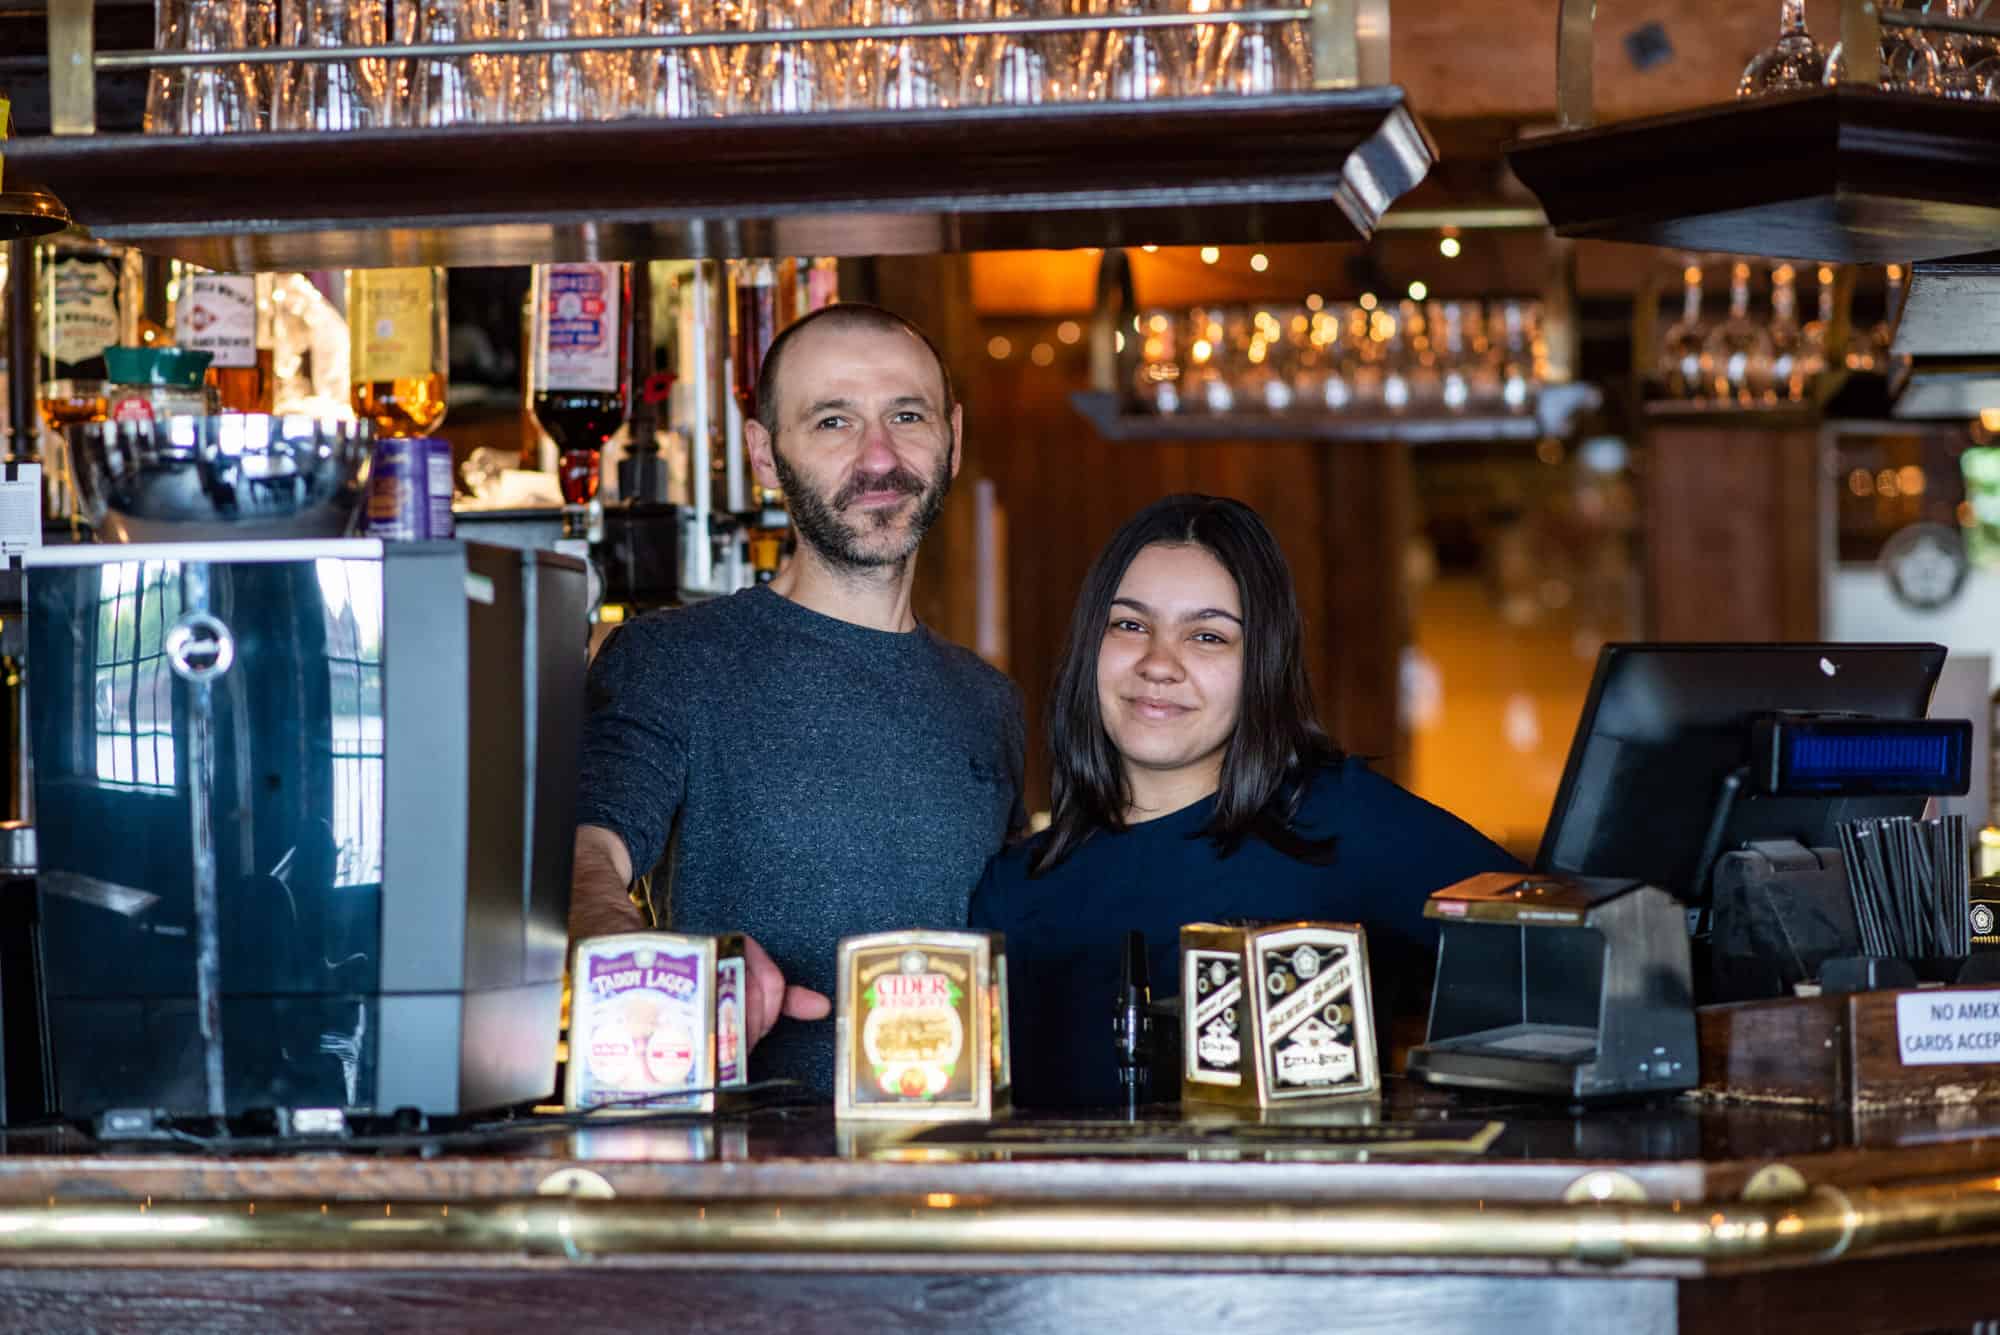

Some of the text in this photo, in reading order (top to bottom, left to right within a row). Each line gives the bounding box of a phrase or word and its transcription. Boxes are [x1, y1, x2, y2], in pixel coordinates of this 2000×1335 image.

[877, 975, 946, 997] CIDER
[1930, 1002, 2000, 1021] NO AMEX
[1904, 1033, 1954, 1053] CARDS
